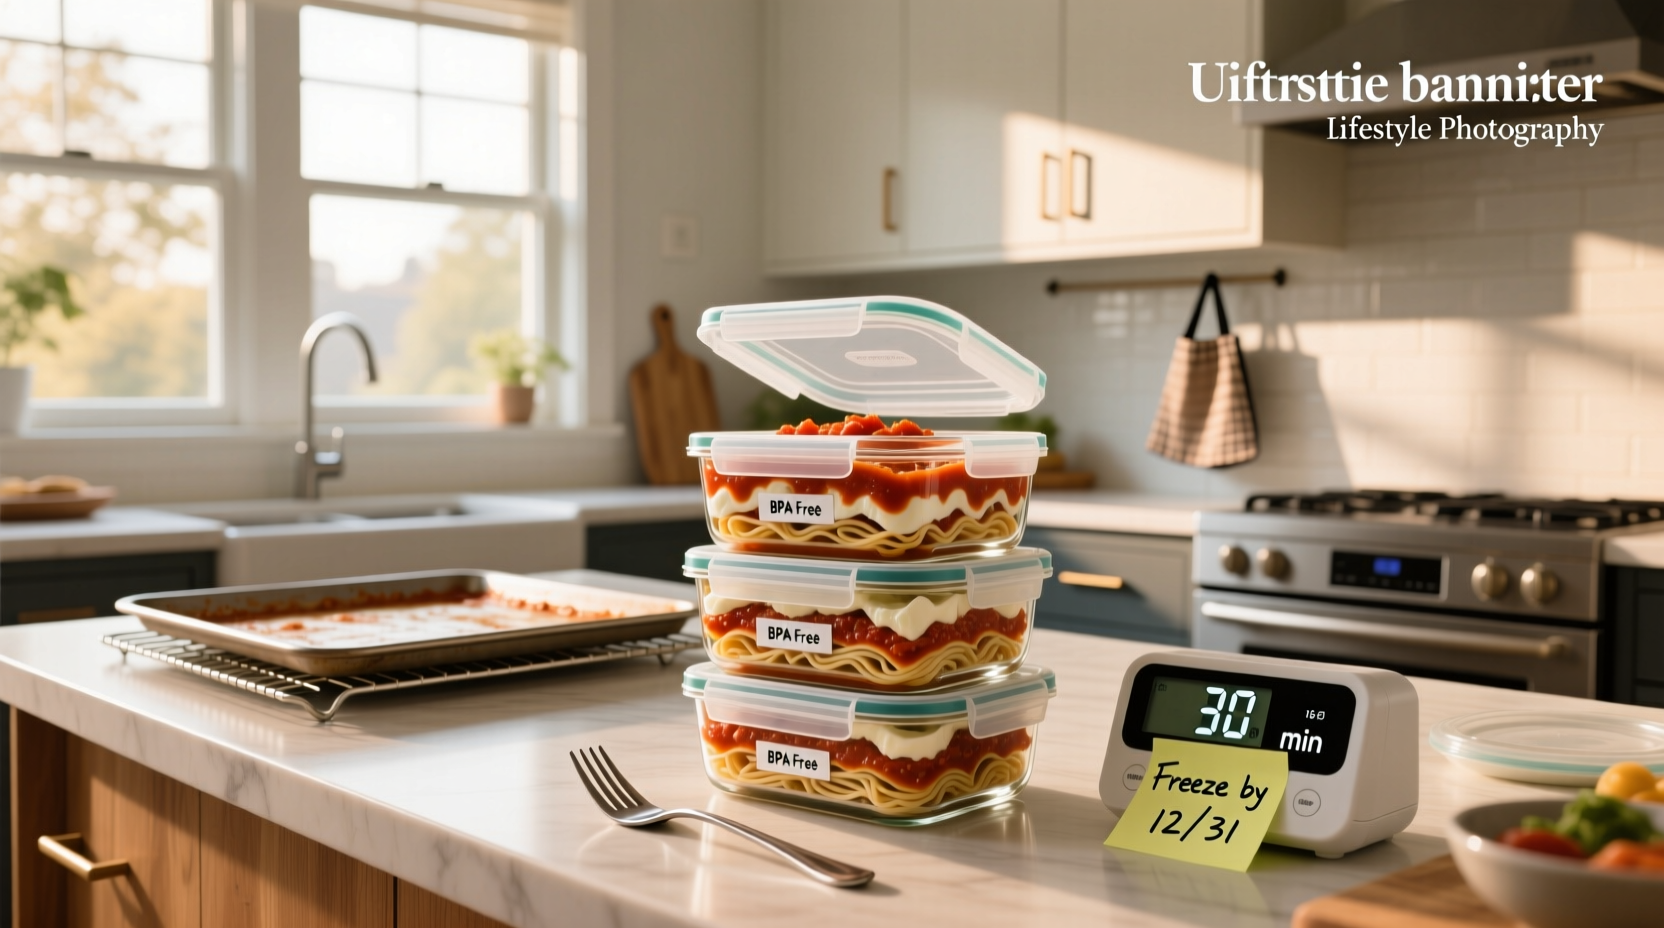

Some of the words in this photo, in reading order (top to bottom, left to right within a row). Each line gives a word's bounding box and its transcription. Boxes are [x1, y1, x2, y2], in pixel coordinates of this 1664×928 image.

[770, 500, 793, 514] BPA
[796, 501, 822, 516] Free
[768, 626, 792, 642] BPA
[794, 629, 820, 645] Free
[1194, 686, 1257, 740] 30
[1279, 728, 1323, 754] min
[767, 750, 791, 767] BPA
[793, 753, 818, 771] Free
[1152, 761, 1229, 797] Freeze
[1239, 774, 1269, 811] by
[1149, 805, 1240, 844] 12/31
